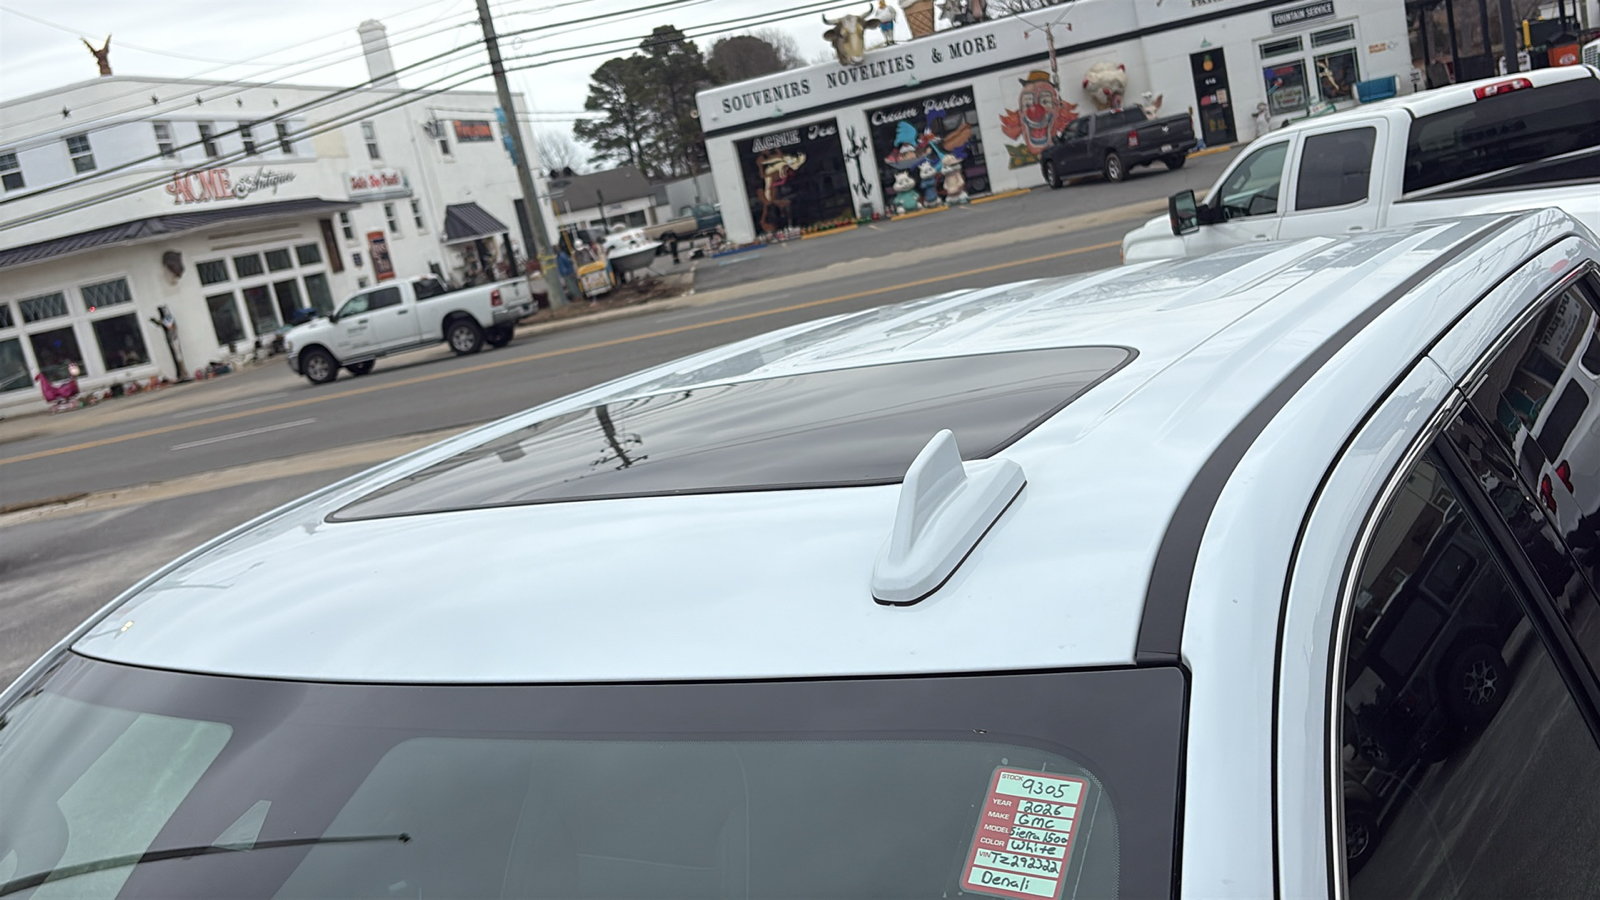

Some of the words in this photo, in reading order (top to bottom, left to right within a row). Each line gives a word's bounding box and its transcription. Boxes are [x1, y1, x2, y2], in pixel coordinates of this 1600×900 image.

[1273, 9, 1305, 25] FOUNTAIN
[1305, 2, 1332, 18] SERVICE
[722, 79, 811, 112] SOUVENIRS
[826, 54, 915, 89] NOVELTIES
[931, 47, 944, 64] &
[948, 33, 997, 59] MORE
[872, 107, 919, 126] Cream
[922, 93, 972, 115] Parlor
[752, 129, 801, 153] ACME
[807, 124, 837, 140] Ice
[166, 168, 236, 205] ACME
[1001, 773, 1024, 781] STOCK
[1022, 779, 1070, 798] 9305
[992, 798, 1012, 807] YEAR
[1023, 801, 1064, 816] 2026
[987, 811, 1010, 821] MAKE
[983, 824, 1010, 834] MODEL
[1009, 826, 1040, 841] Sierra
[1042, 832, 1069, 844] 1500
[979, 836, 1005, 847] COLOR
[980, 870, 1031, 892] Denali
